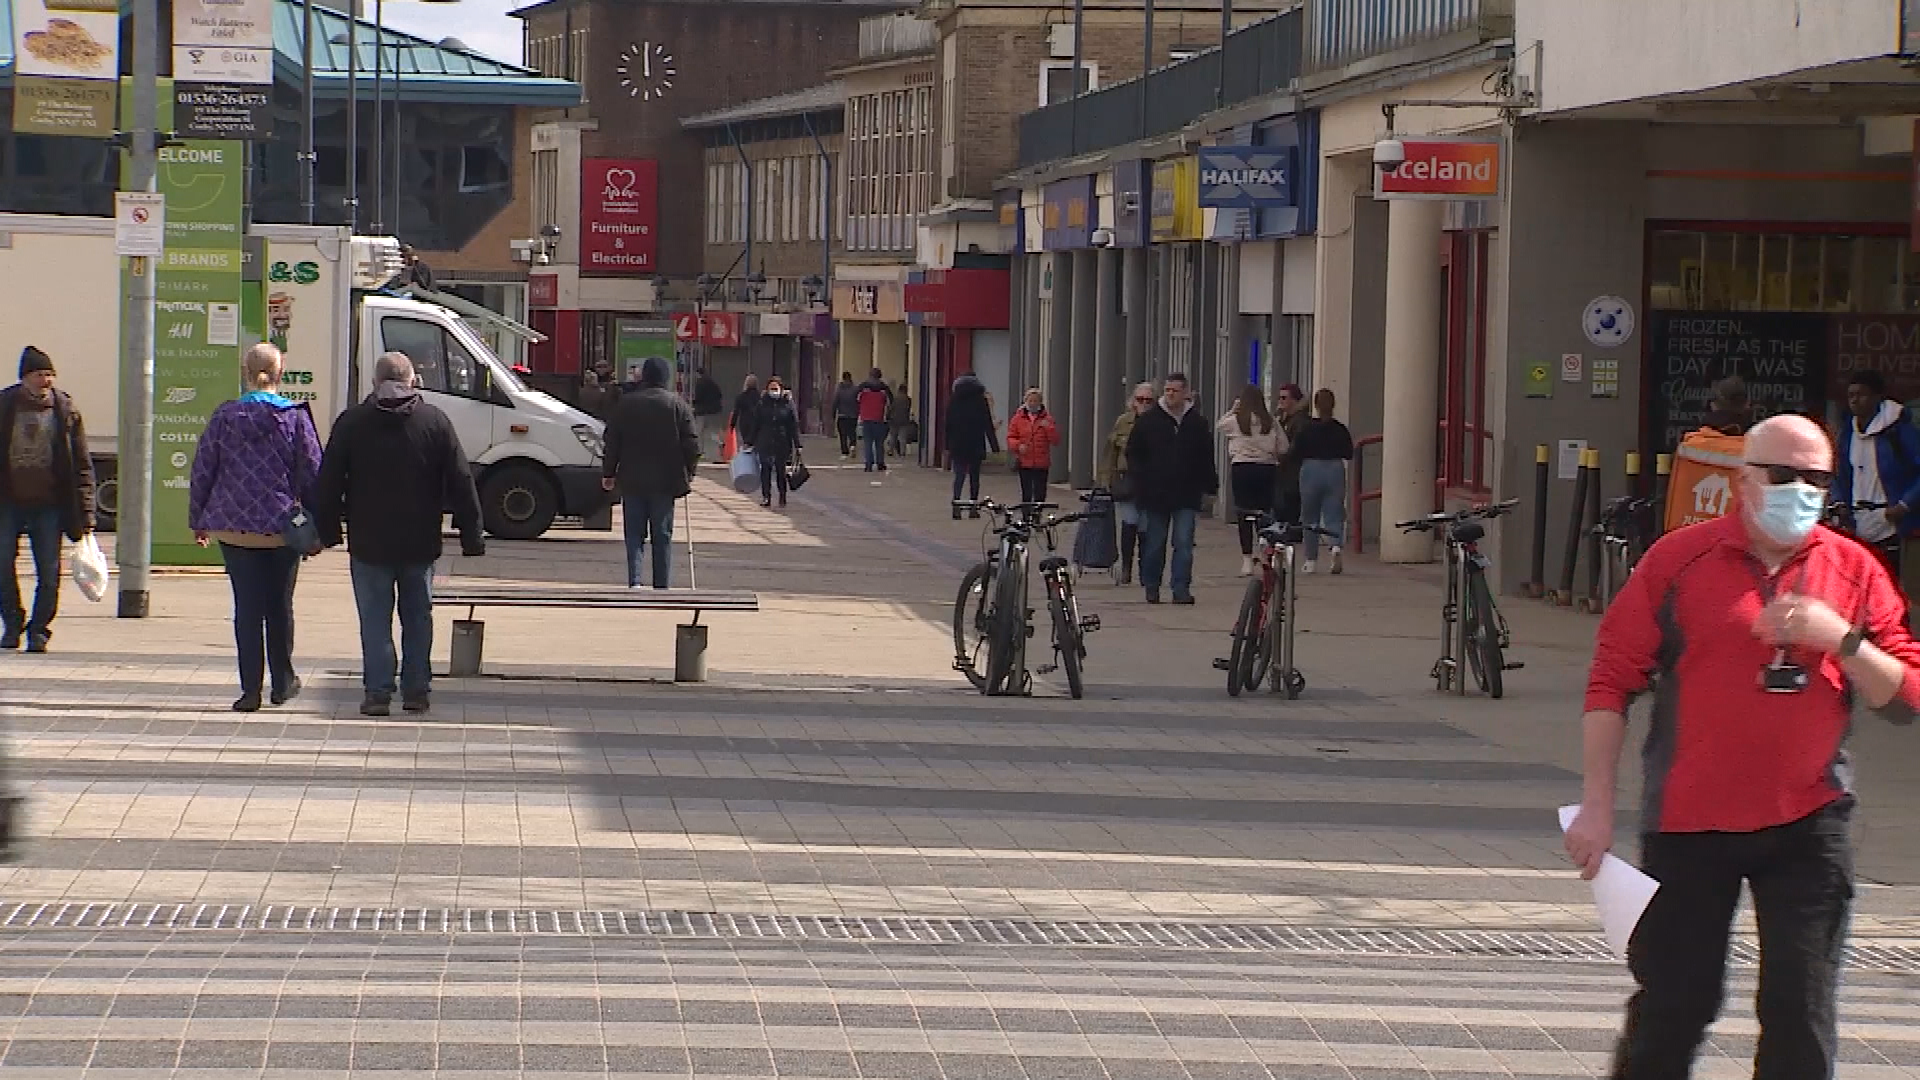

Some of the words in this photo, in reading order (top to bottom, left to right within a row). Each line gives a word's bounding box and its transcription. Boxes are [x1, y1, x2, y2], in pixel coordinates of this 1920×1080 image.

[158, 148, 223, 164] ELCOME
[1201, 169, 1286, 185] HALIFAX
[165, 221, 187, 231] OWN
[592, 221, 649, 234] Furniture
[615, 237, 625, 249] &
[168, 253, 229, 267] BRANDS
[592, 252, 647, 265] Electrical
[268, 260, 321, 285] &S
[158, 281, 209, 292] RIMARK
[1667, 337, 1729, 354] FRESH
[1736, 339, 1761, 355] AS
[1768, 339, 1808, 355] THE
[1667, 356, 1711, 375] DAY
[1722, 357, 1744, 376] IT
[1752, 357, 1807, 377] WAS
[281, 371, 313, 384] ATS
[159, 432, 198, 442] COSTA
